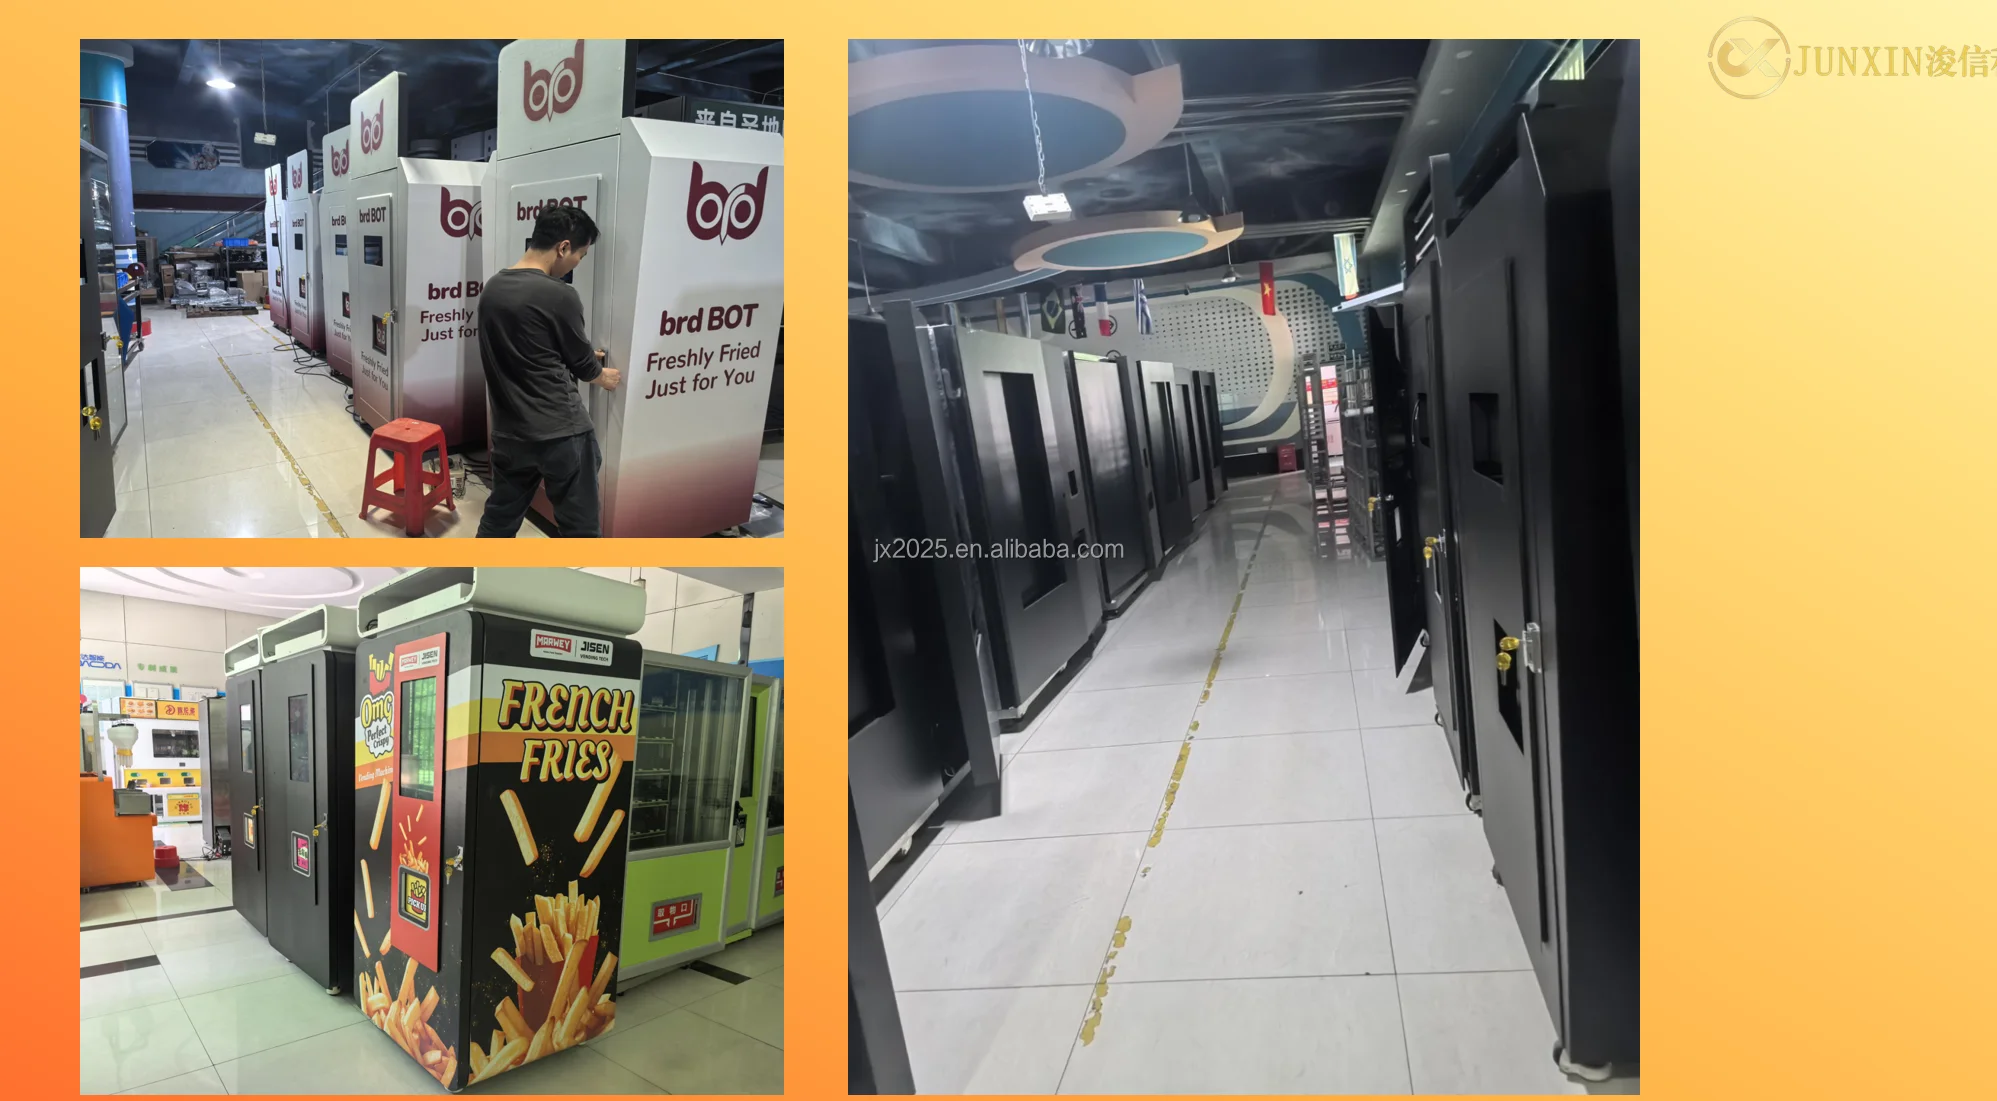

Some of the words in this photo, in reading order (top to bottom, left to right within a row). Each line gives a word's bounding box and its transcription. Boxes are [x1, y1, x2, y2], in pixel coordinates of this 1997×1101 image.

[695, 108, 784, 133] 来自圣地
[331, 215, 340, 226] brd
[359, 208, 370, 223] brd
[371, 207, 386, 222] BOT
[428, 281, 462, 300] brd
[420, 308, 473, 324] Freshly
[660, 310, 703, 336] brd
[707, 303, 759, 331] BOT
[421, 327, 453, 342] Just
[361, 351, 376, 370] Freshly
[376, 361, 389, 377] Fried
[647, 347, 714, 372] Freshly
[719, 340, 761, 362] Fried
[361, 365, 371, 379] Just
[371, 371, 379, 382] for
[379, 377, 388, 391] You
[645, 376, 687, 400] Just
[692, 373, 718, 392] for
[724, 368, 755, 386] You
[536, 635, 571, 650] MARWEY
[581, 641, 610, 655] JISEN
[498, 679, 635, 734] FRENCH
[367, 725, 387, 743] Perfect
[373, 738, 389, 749] Crispy
[520, 738, 613, 784] FRIES
